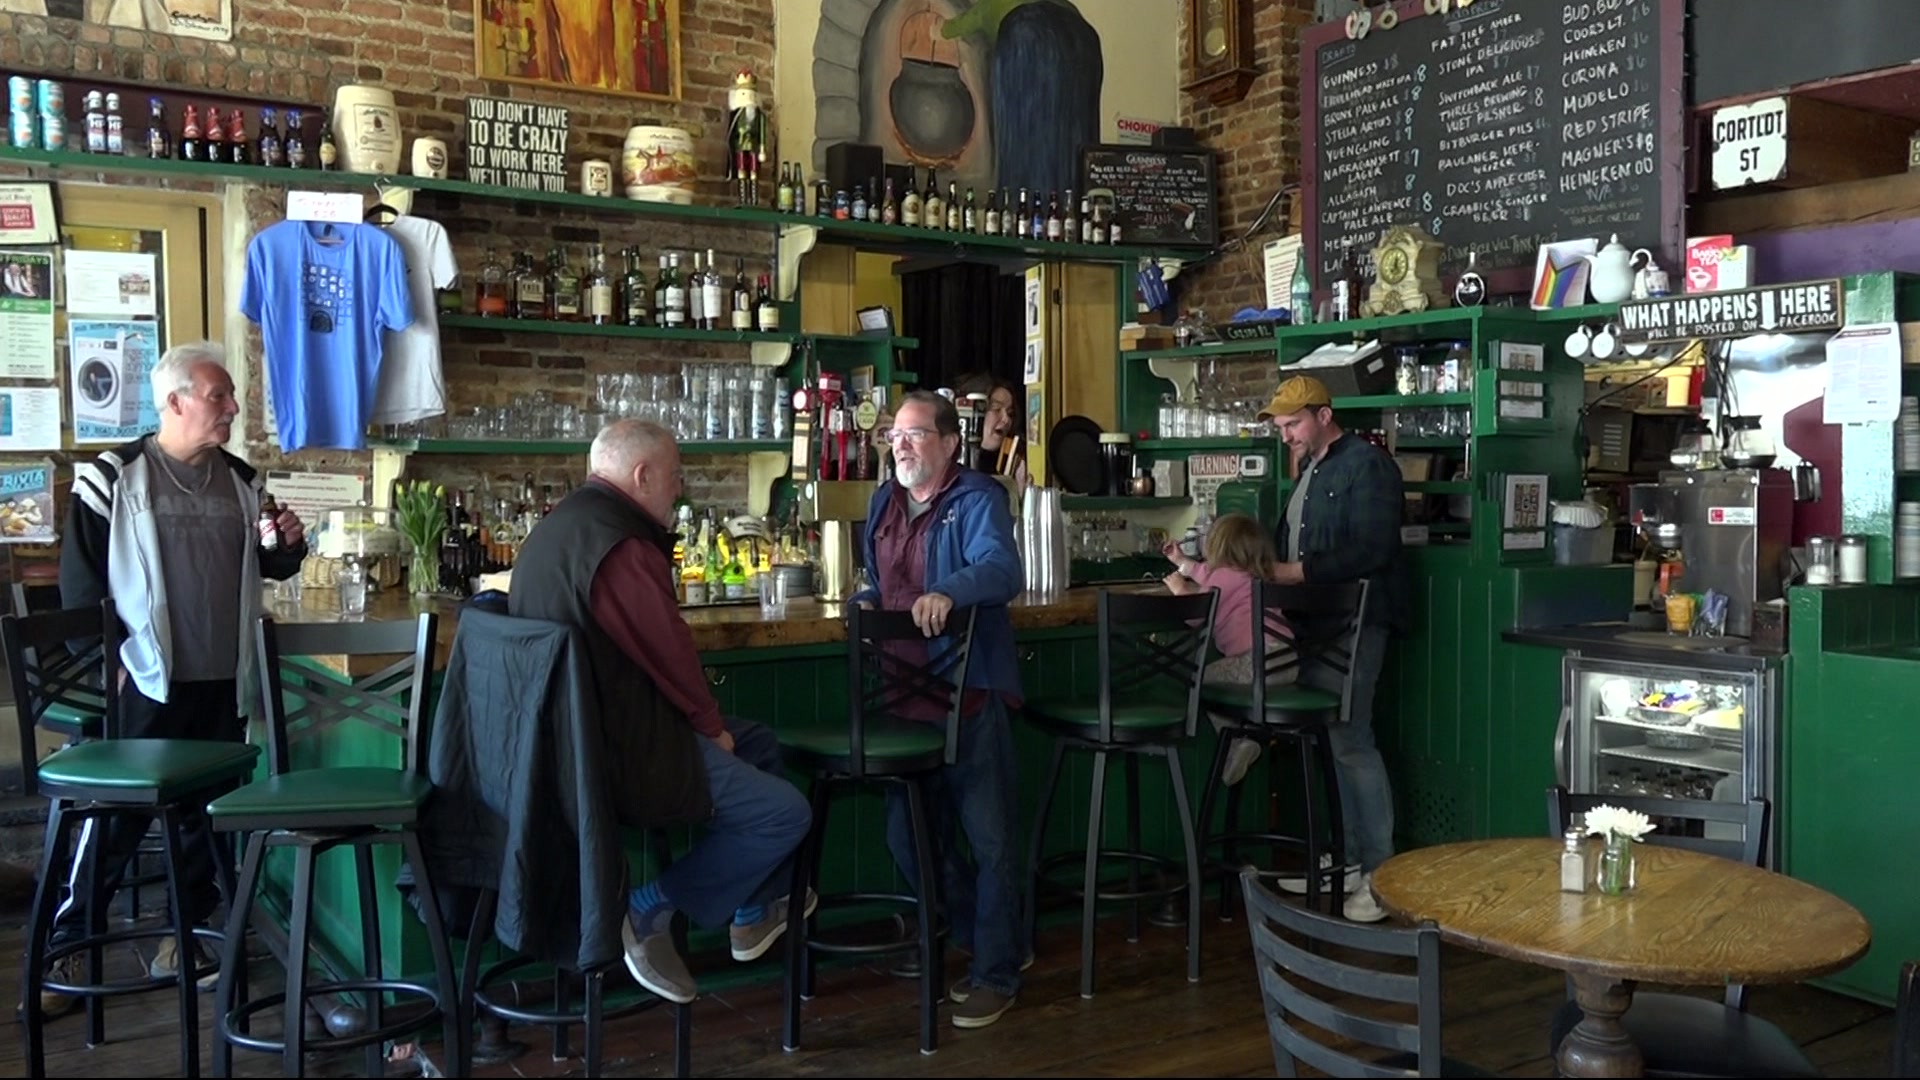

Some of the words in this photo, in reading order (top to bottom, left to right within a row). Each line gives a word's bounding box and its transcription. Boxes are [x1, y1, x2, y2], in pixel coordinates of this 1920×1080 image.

[1431, 35, 1456, 52] FAT
[1460, 24, 1485, 41] TIRE
[1460, 37, 1480, 50] ALE
[1563, 22, 1605, 44] COORS
[1439, 53, 1472, 75] STONE
[1477, 35, 1535, 60] DELICIOUS
[1323, 62, 1378, 89] GUINNESS
[1465, 65, 1484, 77] IPA
[1562, 61, 1619, 88] CORONA
[1439, 80, 1498, 105] SWITCHBACK
[1502, 71, 1523, 86] ALE
[1563, 82, 1629, 115] MODELO
[469, 98, 494, 119] YOU
[497, 101, 534, 124] DON'T
[538, 106, 568, 128] HAVE
[1380, 95, 1399, 110] ALE
[1117, 119, 1161, 134] CHOKIN
[1325, 126, 1357, 145] STELLA
[1360, 116, 1391, 133] ARTOIS
[1509, 122, 1533, 136] PILS
[1562, 119, 1596, 142] RED
[1601, 103, 1650, 133] STRIPE
[469, 119, 489, 145] TO
[494, 122, 514, 148] BE
[519, 125, 568, 154] CRAZY
[1326, 136, 1390, 162] YUENGLING
[1561, 134, 1634, 168] MAGNER'S
[1636, 132, 1654, 153] $8
[469, 145, 485, 166] TO
[490, 147, 528, 171] WORK
[532, 152, 568, 174] HERE.
[1438, 151, 1498, 171] PAULANER
[1740, 146, 1760, 172] ST
[505, 170, 539, 191] TRAIN
[542, 174, 568, 194] YOU.
[1348, 167, 1382, 184] LAGER
[1447, 180, 1480, 196] DOC'S
[1485, 173, 1515, 190] APPLE
[1517, 169, 1546, 183] CIDER
[1560, 161, 1631, 193] HEINEKEN
[1328, 186, 1376, 207] ALLAGASH
[1322, 208, 1359, 224] CAPTAIN
[1363, 197, 1412, 216] LAWRENCE
[1344, 218, 1368, 231] PALE
[1371, 212, 1392, 226] ALE
[1622, 302, 1670, 329] WHAT
[1674, 292, 1758, 325] HAPPENS
[1780, 285, 1831, 315] HERE
[1647, 327, 1669, 340] WILL
[1676, 326, 1687, 337] BE
[1695, 321, 1736, 335] POSTED
[1742, 320, 1758, 331] ON
[1779, 312, 1836, 328] FACEBOOK
[1190, 454, 1240, 475] WARNING!
